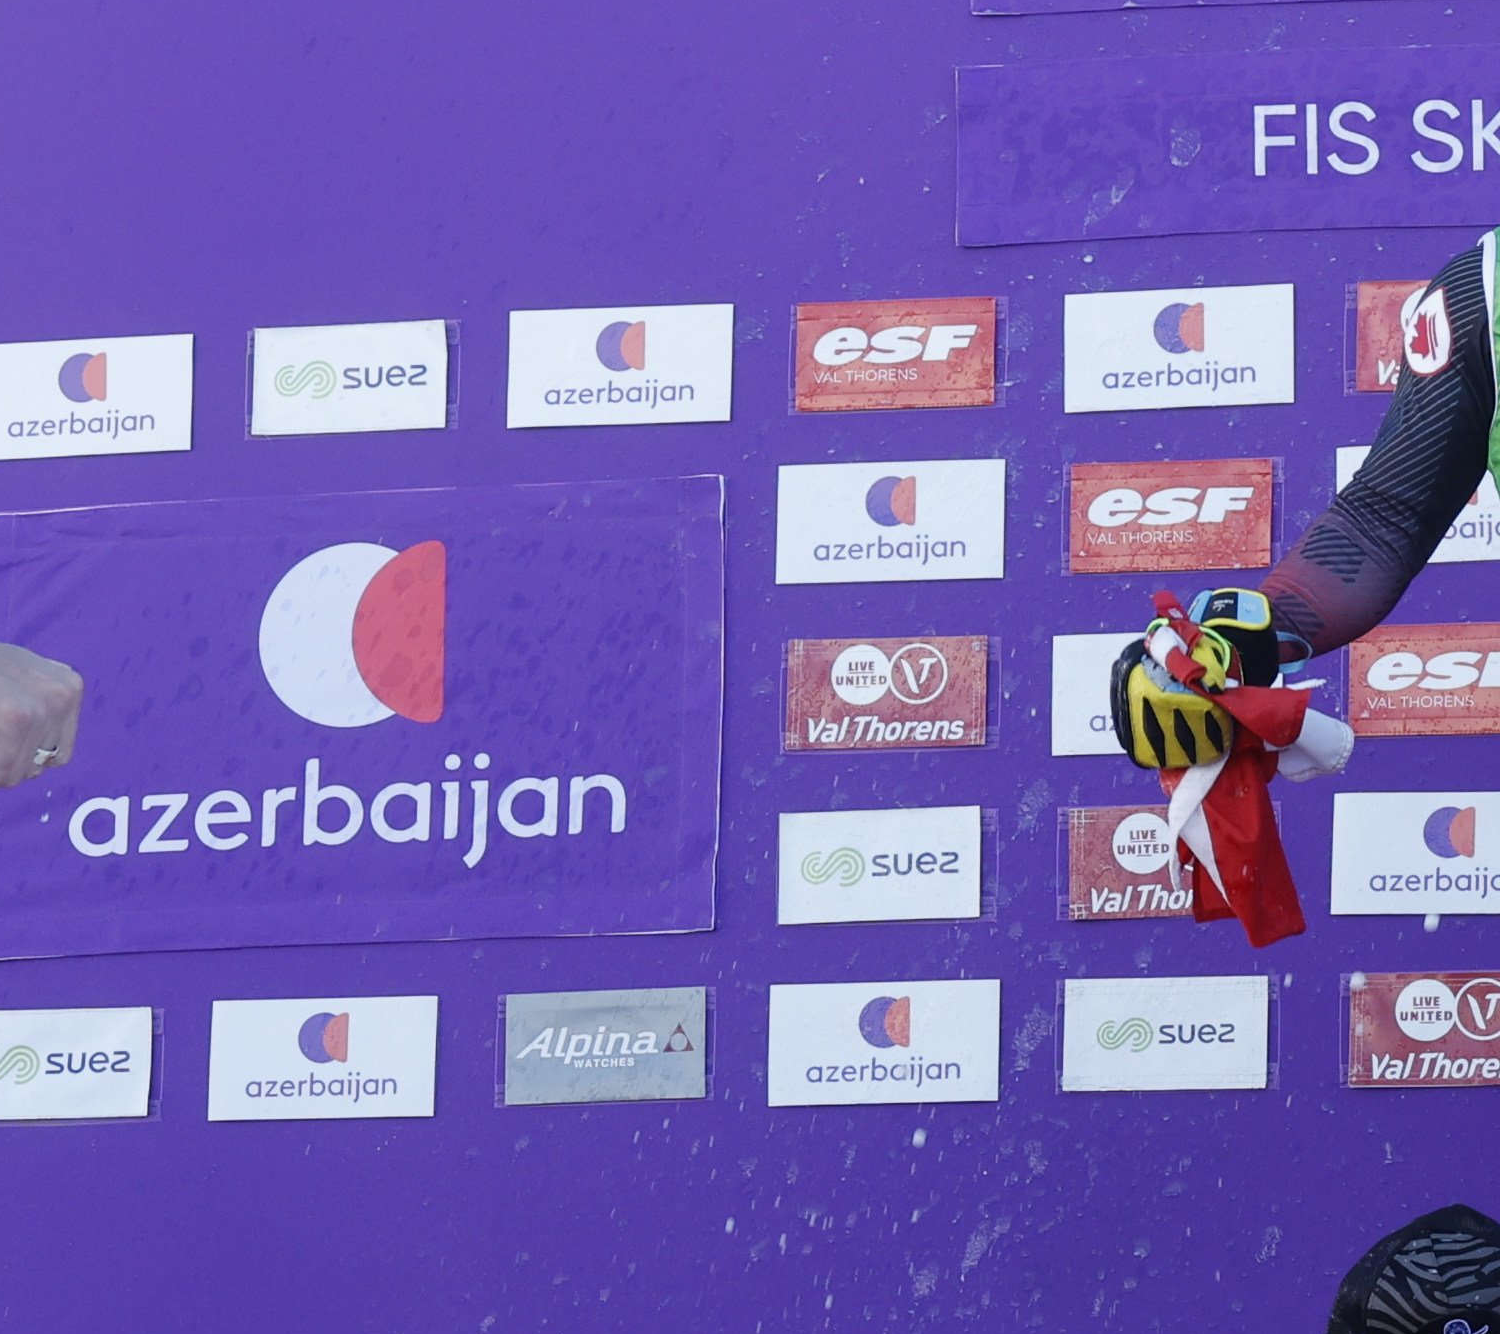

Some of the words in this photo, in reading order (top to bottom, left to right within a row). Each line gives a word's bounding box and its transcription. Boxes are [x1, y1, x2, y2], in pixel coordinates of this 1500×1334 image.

[1254, 100, 1380, 177] FIS
[342, 363, 428, 390] suez
[813, 369, 853, 383] VAL
[856, 367, 918, 382] THORENS
[1101, 359, 1257, 391] azerbaijan
[543, 378, 696, 409] azerbaijan
[7, 409, 156, 440] azerbaijan
[813, 534, 967, 566] azerbaijan
[1087, 531, 1128, 546] VAL
[1131, 529, 1194, 544] THORENS
[848, 660, 876, 673] LIVE
[835, 673, 888, 688] UNITED
[1366, 696, 1407, 709] VAL
[1410, 693, 1475, 708] THORENS
[807, 717, 852, 744] Val
[854, 714, 964, 744] Thorens
[68, 753, 627, 869] azerbaijan
[1129, 829, 1156, 842] LIVE
[1117, 842, 1169, 857] UNITED
[871, 850, 959, 877] suez
[1090, 888, 1132, 915] Val
[1135, 885, 1193, 913] Thor
[1412, 996, 1441, 1007] LIVE
[1400, 1011, 1453, 1022] UNITED
[516, 1024, 659, 1065] Alpina
[1158, 1021, 1235, 1045] suez
[45, 1049, 131, 1075] suez
[573, 1055, 636, 1069] WATCHES
[805, 1057, 961, 1089] azerbaijan
[1371, 1052, 1413, 1080] Val
[244, 1071, 399, 1104] azerbaijan
